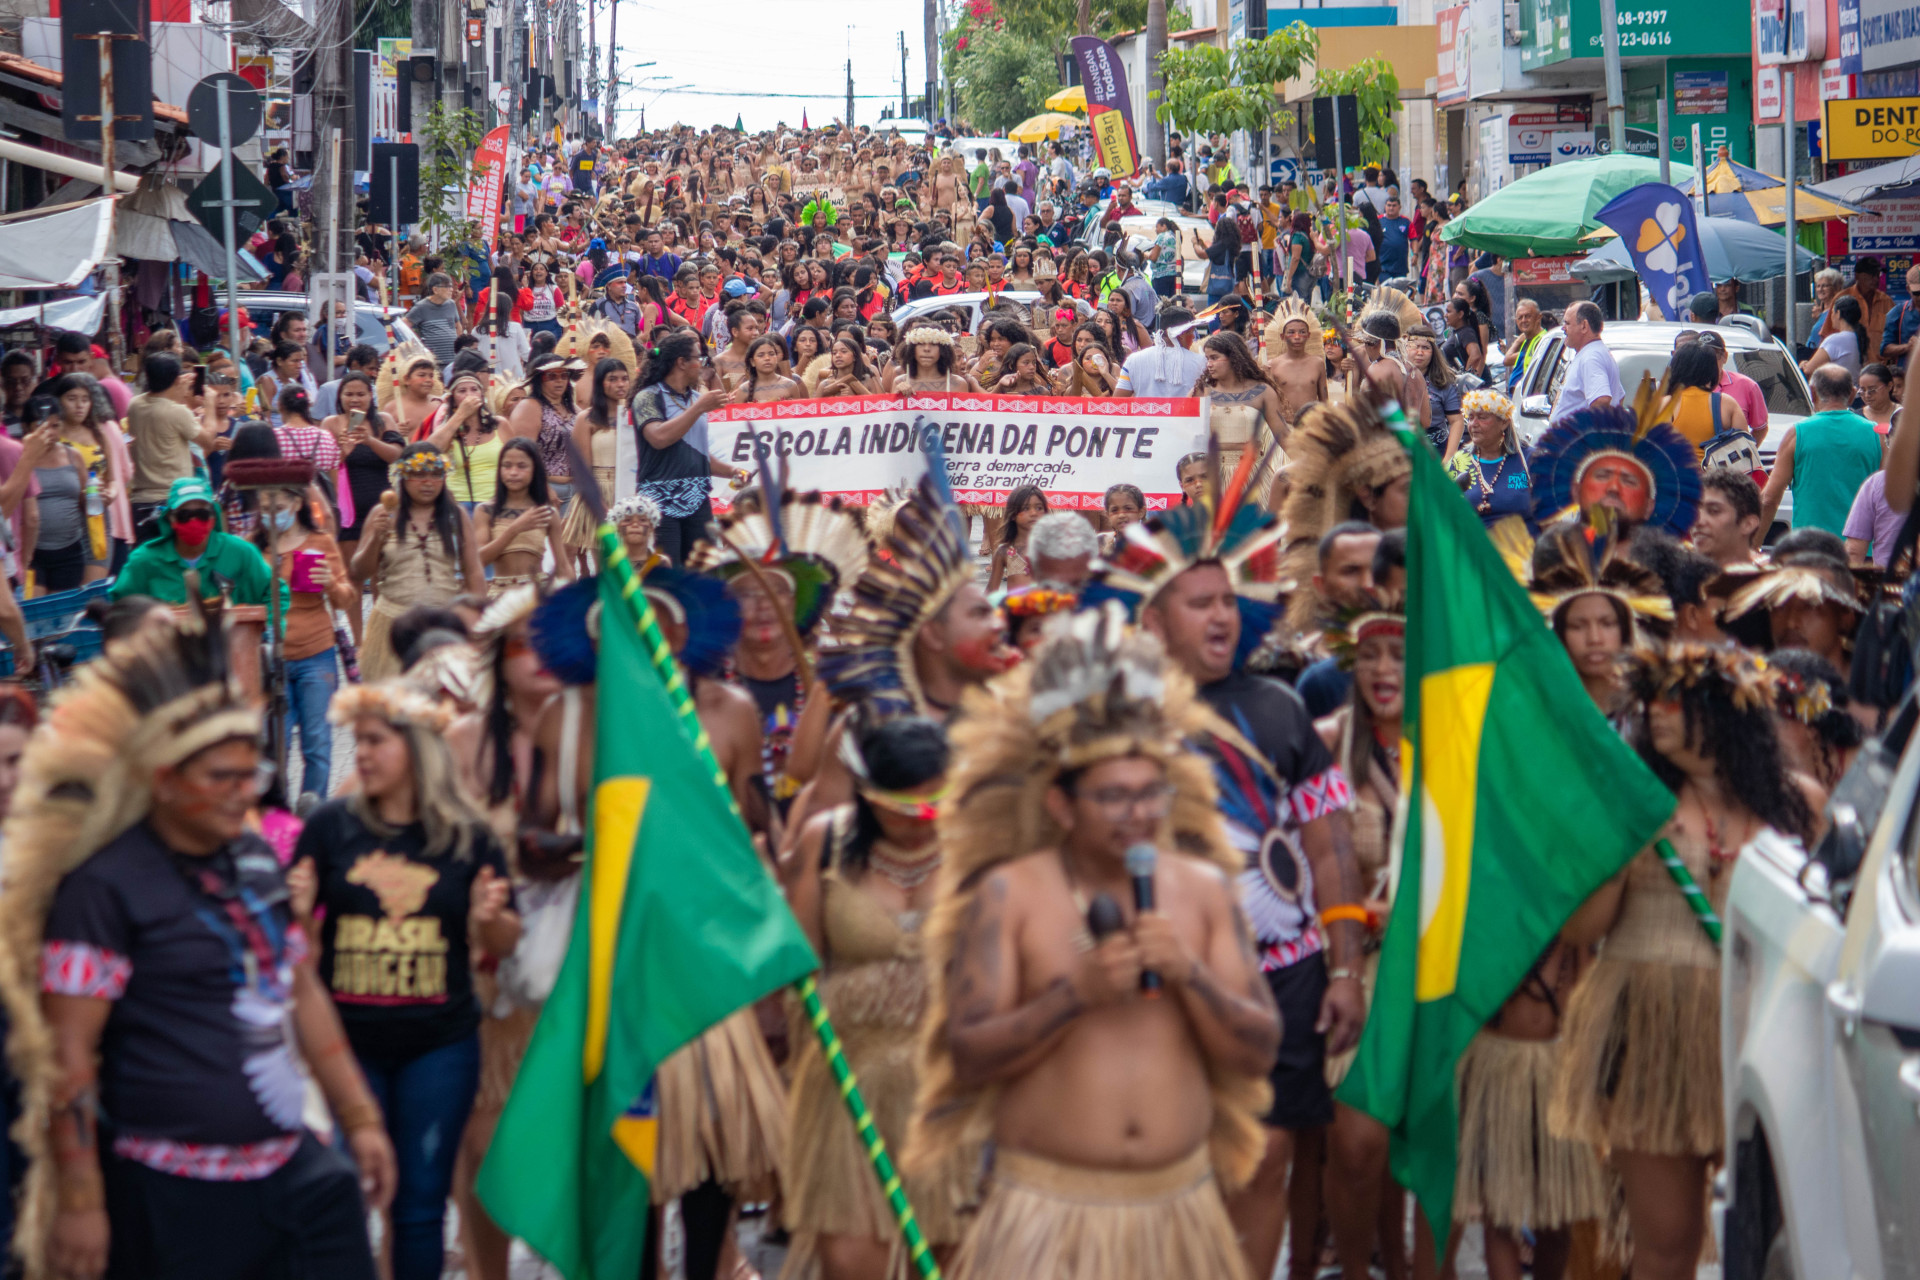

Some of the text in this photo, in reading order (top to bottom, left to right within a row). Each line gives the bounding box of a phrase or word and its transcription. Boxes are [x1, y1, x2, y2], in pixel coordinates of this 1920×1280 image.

[1617, 10, 1667, 25] 68-9397
[1599, 31, 1671, 47] 9123-0616
[1855, 106, 1919, 127] DENT
[1872, 129, 1899, 143] DO
[1102, 114, 1125, 176] BanBan
[480, 160, 501, 246] ORATORIAIS
[732, 415, 1160, 462] ESCOLA INDÍGENA DA PONTE
[986, 459, 1076, 475] demarcada,
[975, 473, 1057, 489] garantida!
